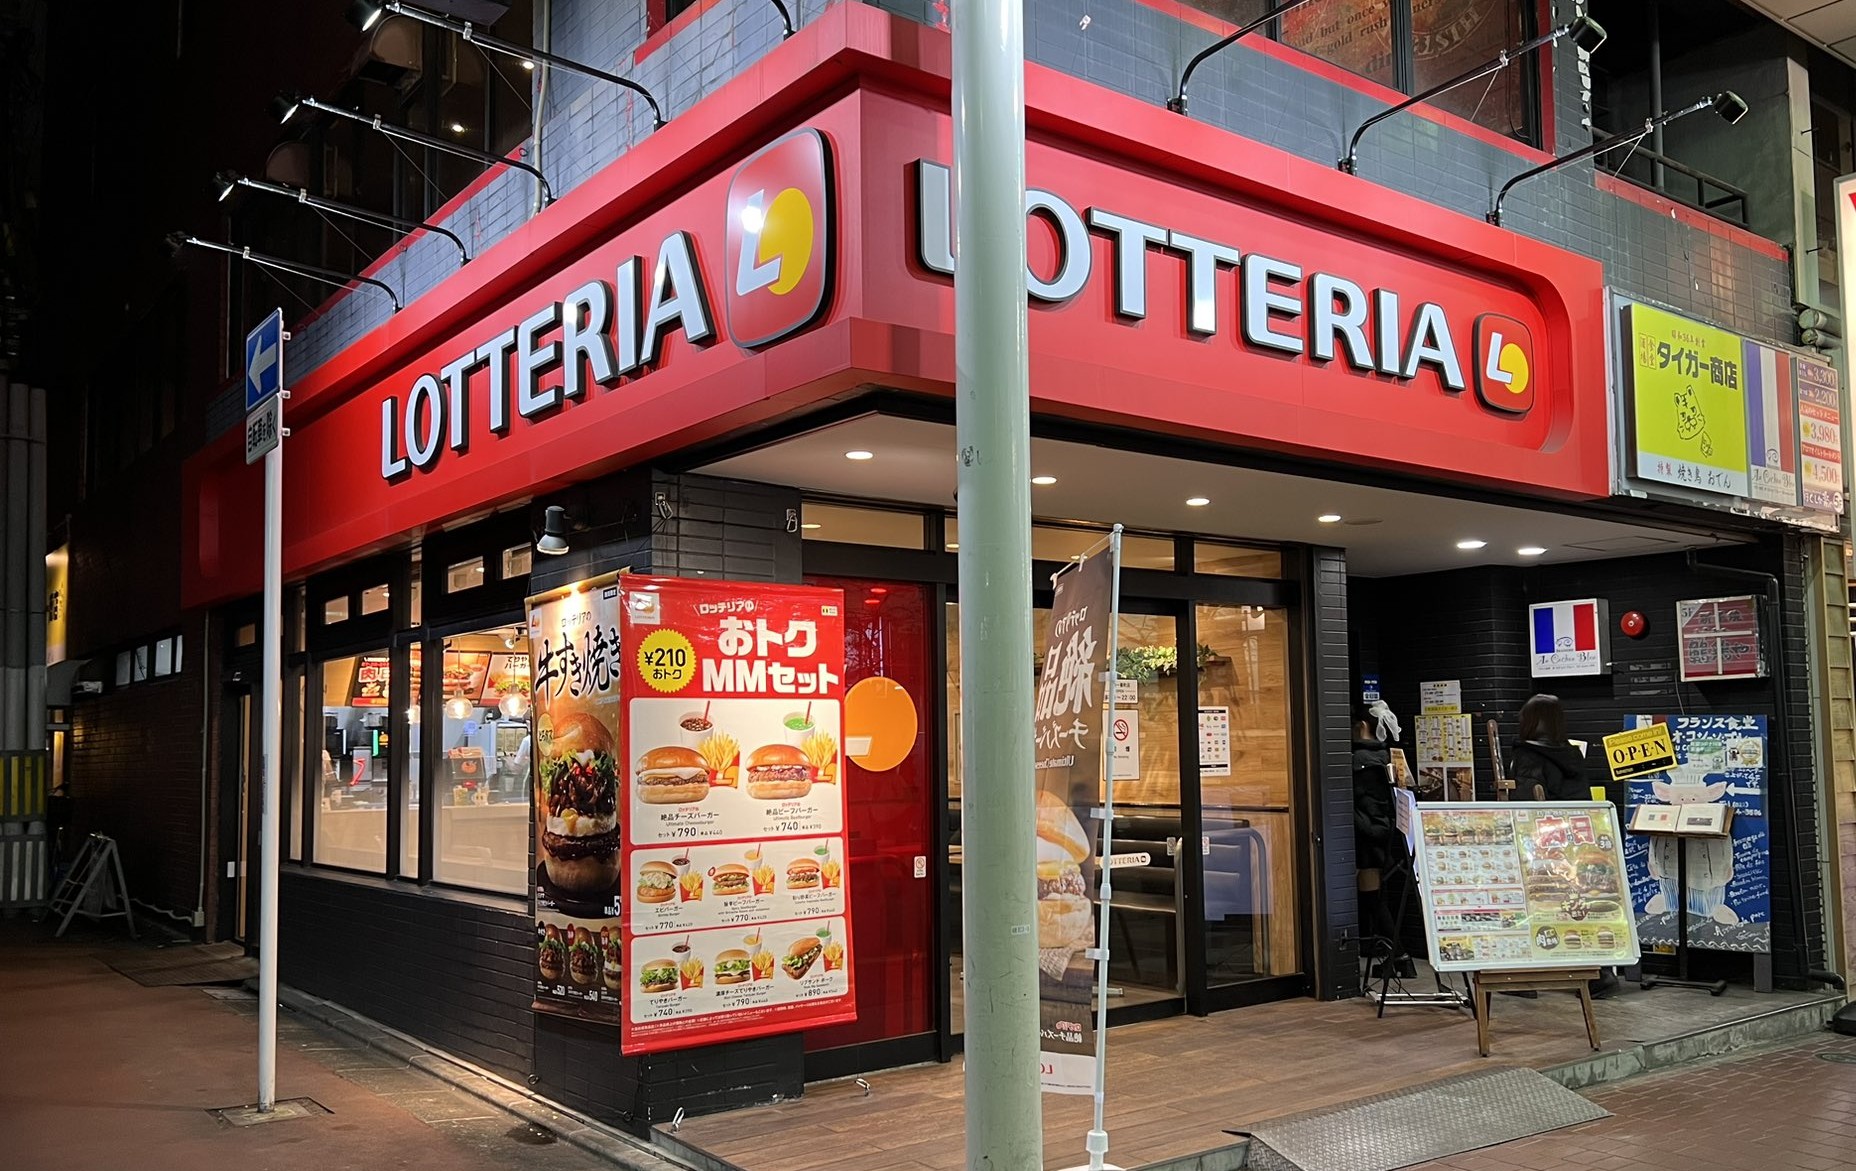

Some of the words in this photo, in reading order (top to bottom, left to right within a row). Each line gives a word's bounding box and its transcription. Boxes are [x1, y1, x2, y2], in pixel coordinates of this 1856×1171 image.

[1319, 20, 1341, 38] but
[1347, 5, 1375, 25] once
[1326, 32, 1353, 55] gold
[1360, 16, 1388, 37] rush
[381, 230, 715, 484] LOTTERIA
[1657, 341, 1737, 390] タイガー商店
[1678, 463, 1702, 485] 焼き鳥
[699, 601, 754, 615] ロッテリアの
[717, 616, 818, 657] おトク
[644, 647, 686, 668] ¥210
[653, 669, 682, 680] おトク
[702, 658, 839, 694] MMセット
[1677, 715, 1759, 730] フランス食堂
[660, 812, 719, 821] 絶品チーズバーガー
[766, 807, 818, 815] 絶品ビーフバーガー
[775, 821, 799, 831] ¥740
[671, 827, 697, 838] ¥790
[655, 906, 684, 914] エビバーガー
[731, 914, 749, 922] ¥770
[655, 921, 674, 930] ¥770
[649, 996, 688, 1005] てりやきバーガー
[732, 998, 749, 1007] ¥790
[653, 1008, 673, 1017] ¥740
